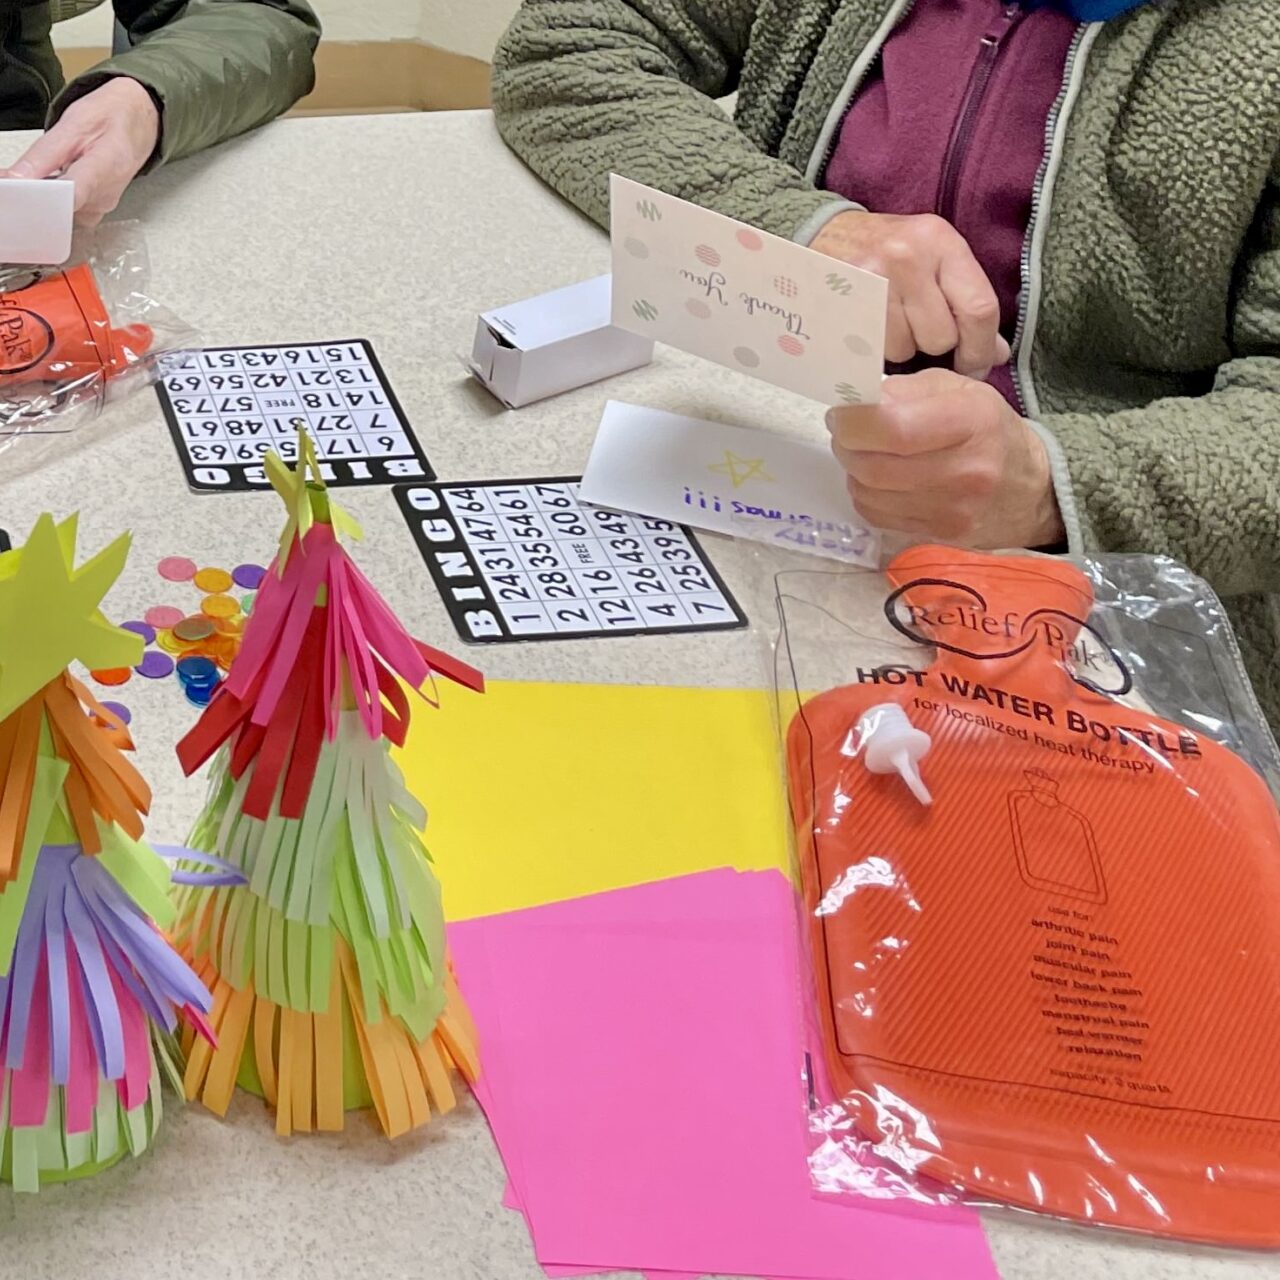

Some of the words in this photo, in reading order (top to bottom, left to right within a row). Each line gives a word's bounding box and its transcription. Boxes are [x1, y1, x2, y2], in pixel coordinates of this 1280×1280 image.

[679, 269, 728, 305] You
[739, 291, 810, 340] Thank
[204, 353, 235, 368] 51
[242, 352, 278, 367] 43
[284, 350, 319, 364] 16
[327, 347, 361, 362] 15
[168, 376, 201, 392] 69
[209, 375, 244, 390] 56
[250, 373, 288, 388] 42
[297, 370, 331, 386] 21
[335, 368, 372, 384] 13
[173, 398, 212, 414] 73
[220, 396, 253, 412] 57
[264, 399, 296, 407] FREE
[302, 393, 340, 408] 18
[346, 390, 383, 407] 14
[186, 421, 218, 437] 61
[225, 420, 263, 436] 48
[273, 417, 305, 433] 31
[316, 415, 352, 431] 27
[370, 413, 387, 429] 7
[237, 442, 271, 459] 59
[327, 438, 362, 455] 17
[377, 436, 394, 452] 6
[188, 444, 227, 462] 63
[445, 487, 485, 514] 64
[493, 490, 528, 510] 61
[534, 485, 571, 508] 67
[463, 517, 497, 541] 47
[506, 514, 543, 538] 54
[550, 512, 587, 536] 60
[593, 510, 630, 535] 49
[522, 542, 559, 568] 35
[570, 543, 595, 564] FREE
[610, 538, 644, 564] 43
[653, 536, 692, 560] 39
[476, 548, 514, 571] 31
[537, 571, 576, 598] 28
[582, 570, 618, 594] 16
[627, 568, 666, 593] 26
[670, 565, 711, 591] 25
[489, 574, 531, 602] 24
[556, 608, 588, 622] 2
[598, 599, 636, 625] 12
[647, 604, 676, 617] 4
[692, 601, 724, 614] 7
[512, 614, 541, 623] 1
[903, 605, 1021, 638] Relief
[1043, 622, 1106, 673] Pak
[856, 667, 927, 687] HOT
[940, 673, 1054, 725] WATER
[1066, 709, 1202, 757] BOTTLE
[913, 697, 939, 712] for
[946, 703, 1028, 741] localized
[1034, 730, 1075, 756] heat
[1082, 746, 1155, 773] therapy
[1048, 905, 1069, 917] use
[1031, 919, 1085, 938] arthritic
[1089, 932, 1119, 945] pain
[1046, 939, 1076, 953] joint
[1081, 948, 1110, 960] pain
[1034, 954, 1096, 976] muscular
[1101, 969, 1132, 979] pain
[1031, 970, 1068, 986] lower
[1073, 980, 1107, 993] back
[1111, 986, 1143, 997] pain
[1055, 994, 1127, 1011] toothache
[1042, 1009, 1114, 1025] menstrual
[1119, 1020, 1150, 1029] pain
[1068, 1045, 1142, 1062] relaxation
